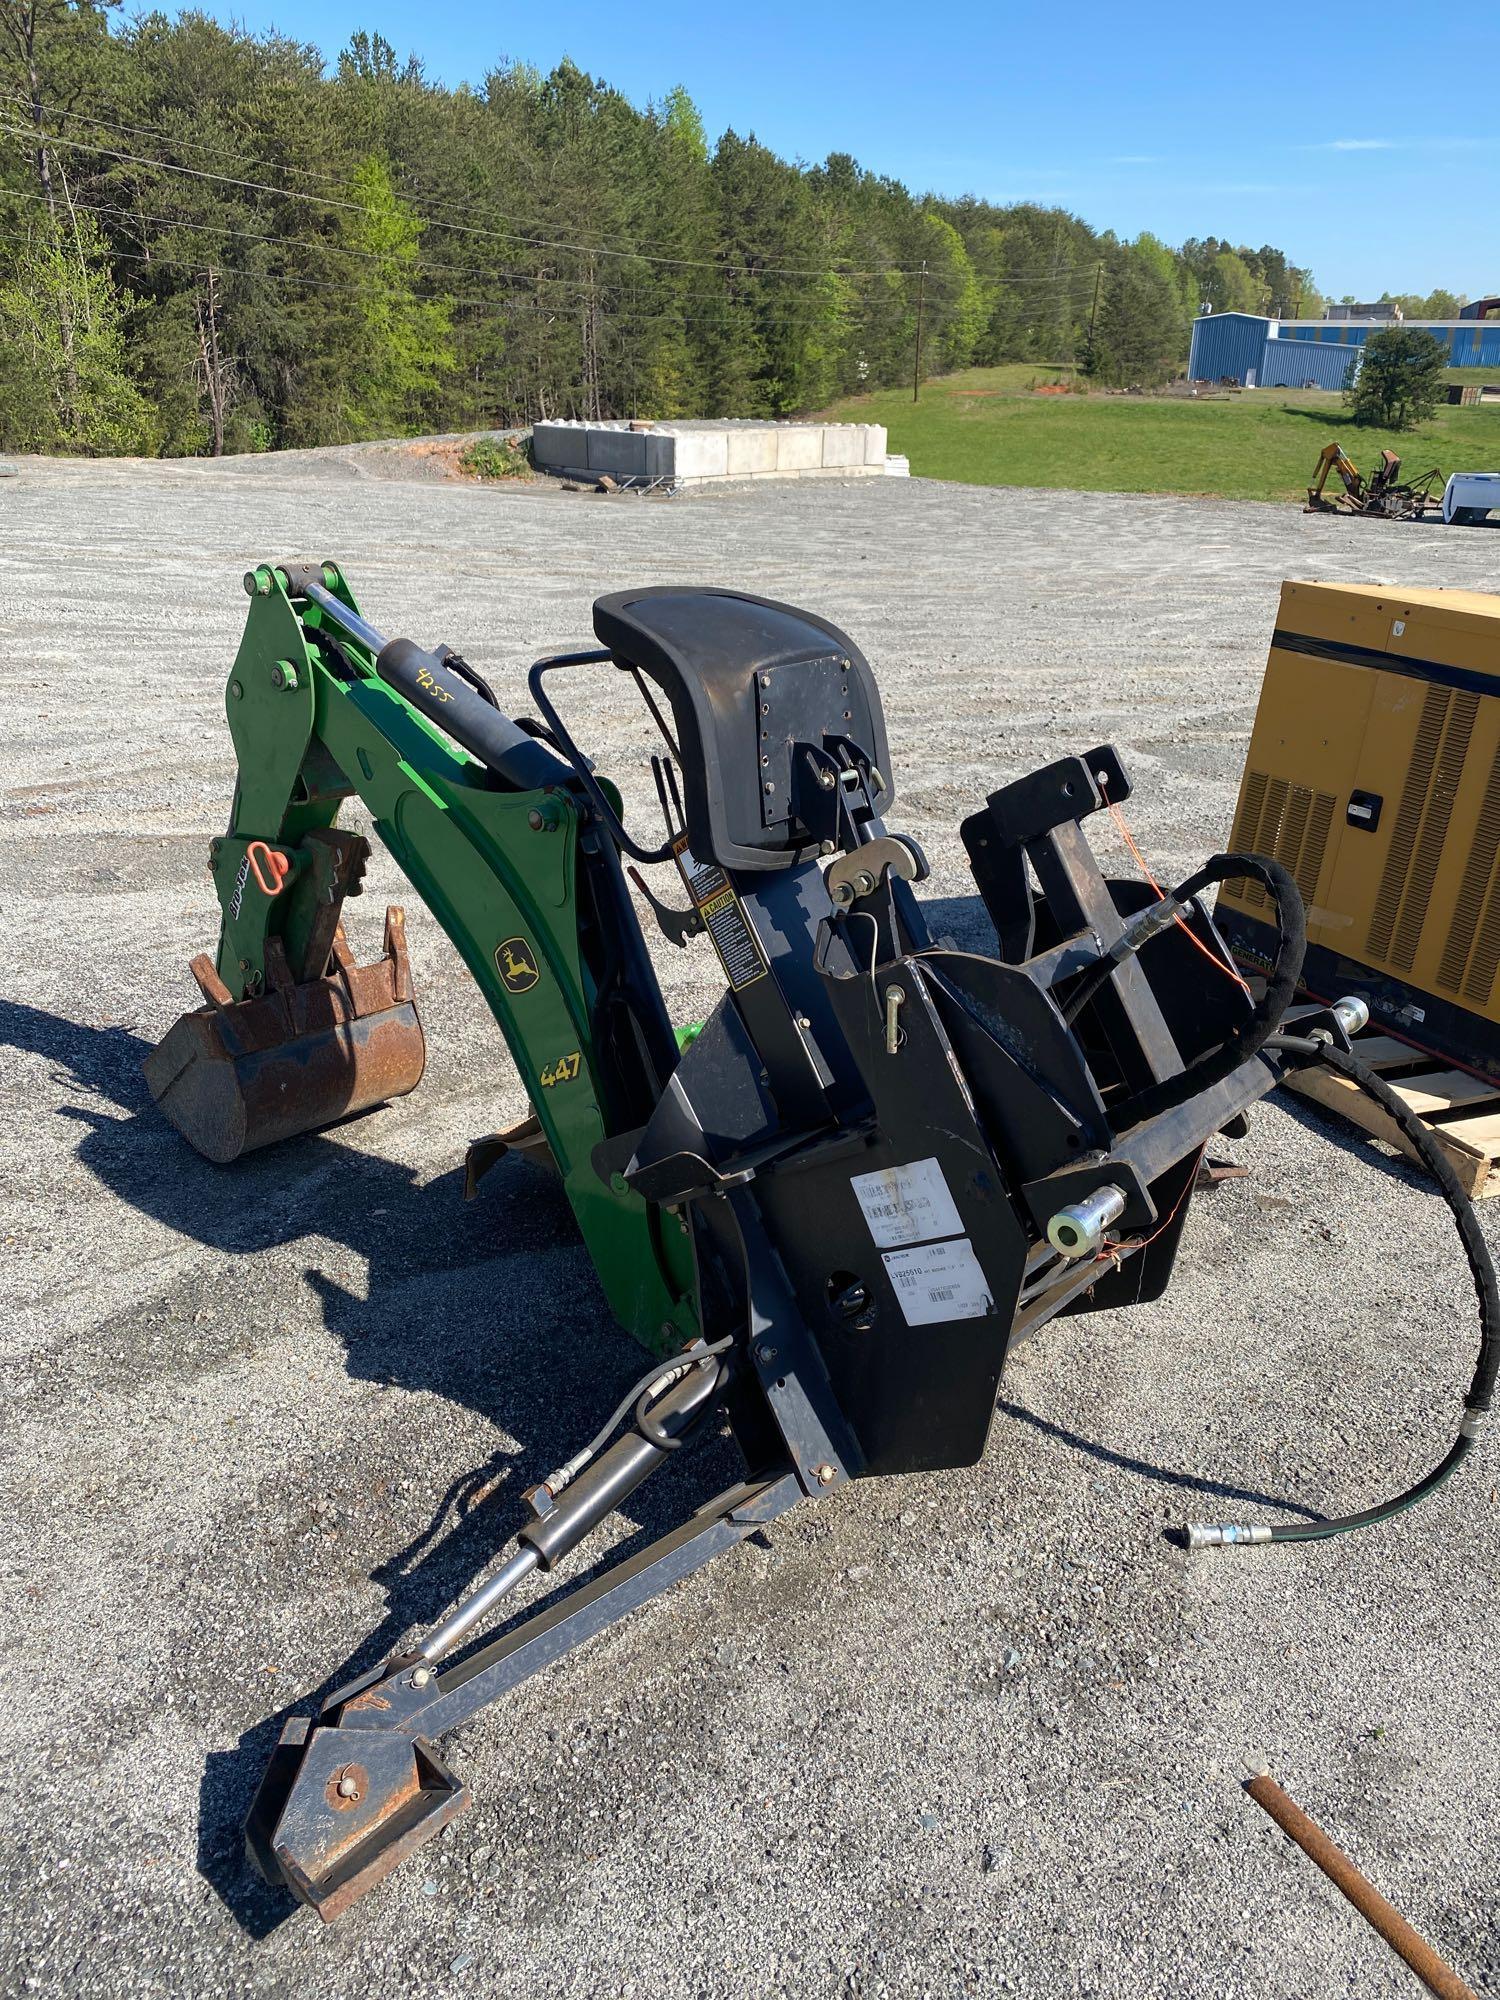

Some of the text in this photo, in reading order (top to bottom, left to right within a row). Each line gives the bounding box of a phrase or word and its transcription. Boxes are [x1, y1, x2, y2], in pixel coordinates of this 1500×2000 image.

[416, 668, 455, 703] 4255
[709, 891, 736, 914] CAUTION
[1231, 947, 1275, 972] GENERATO
[541, 1052, 580, 1086] 447
